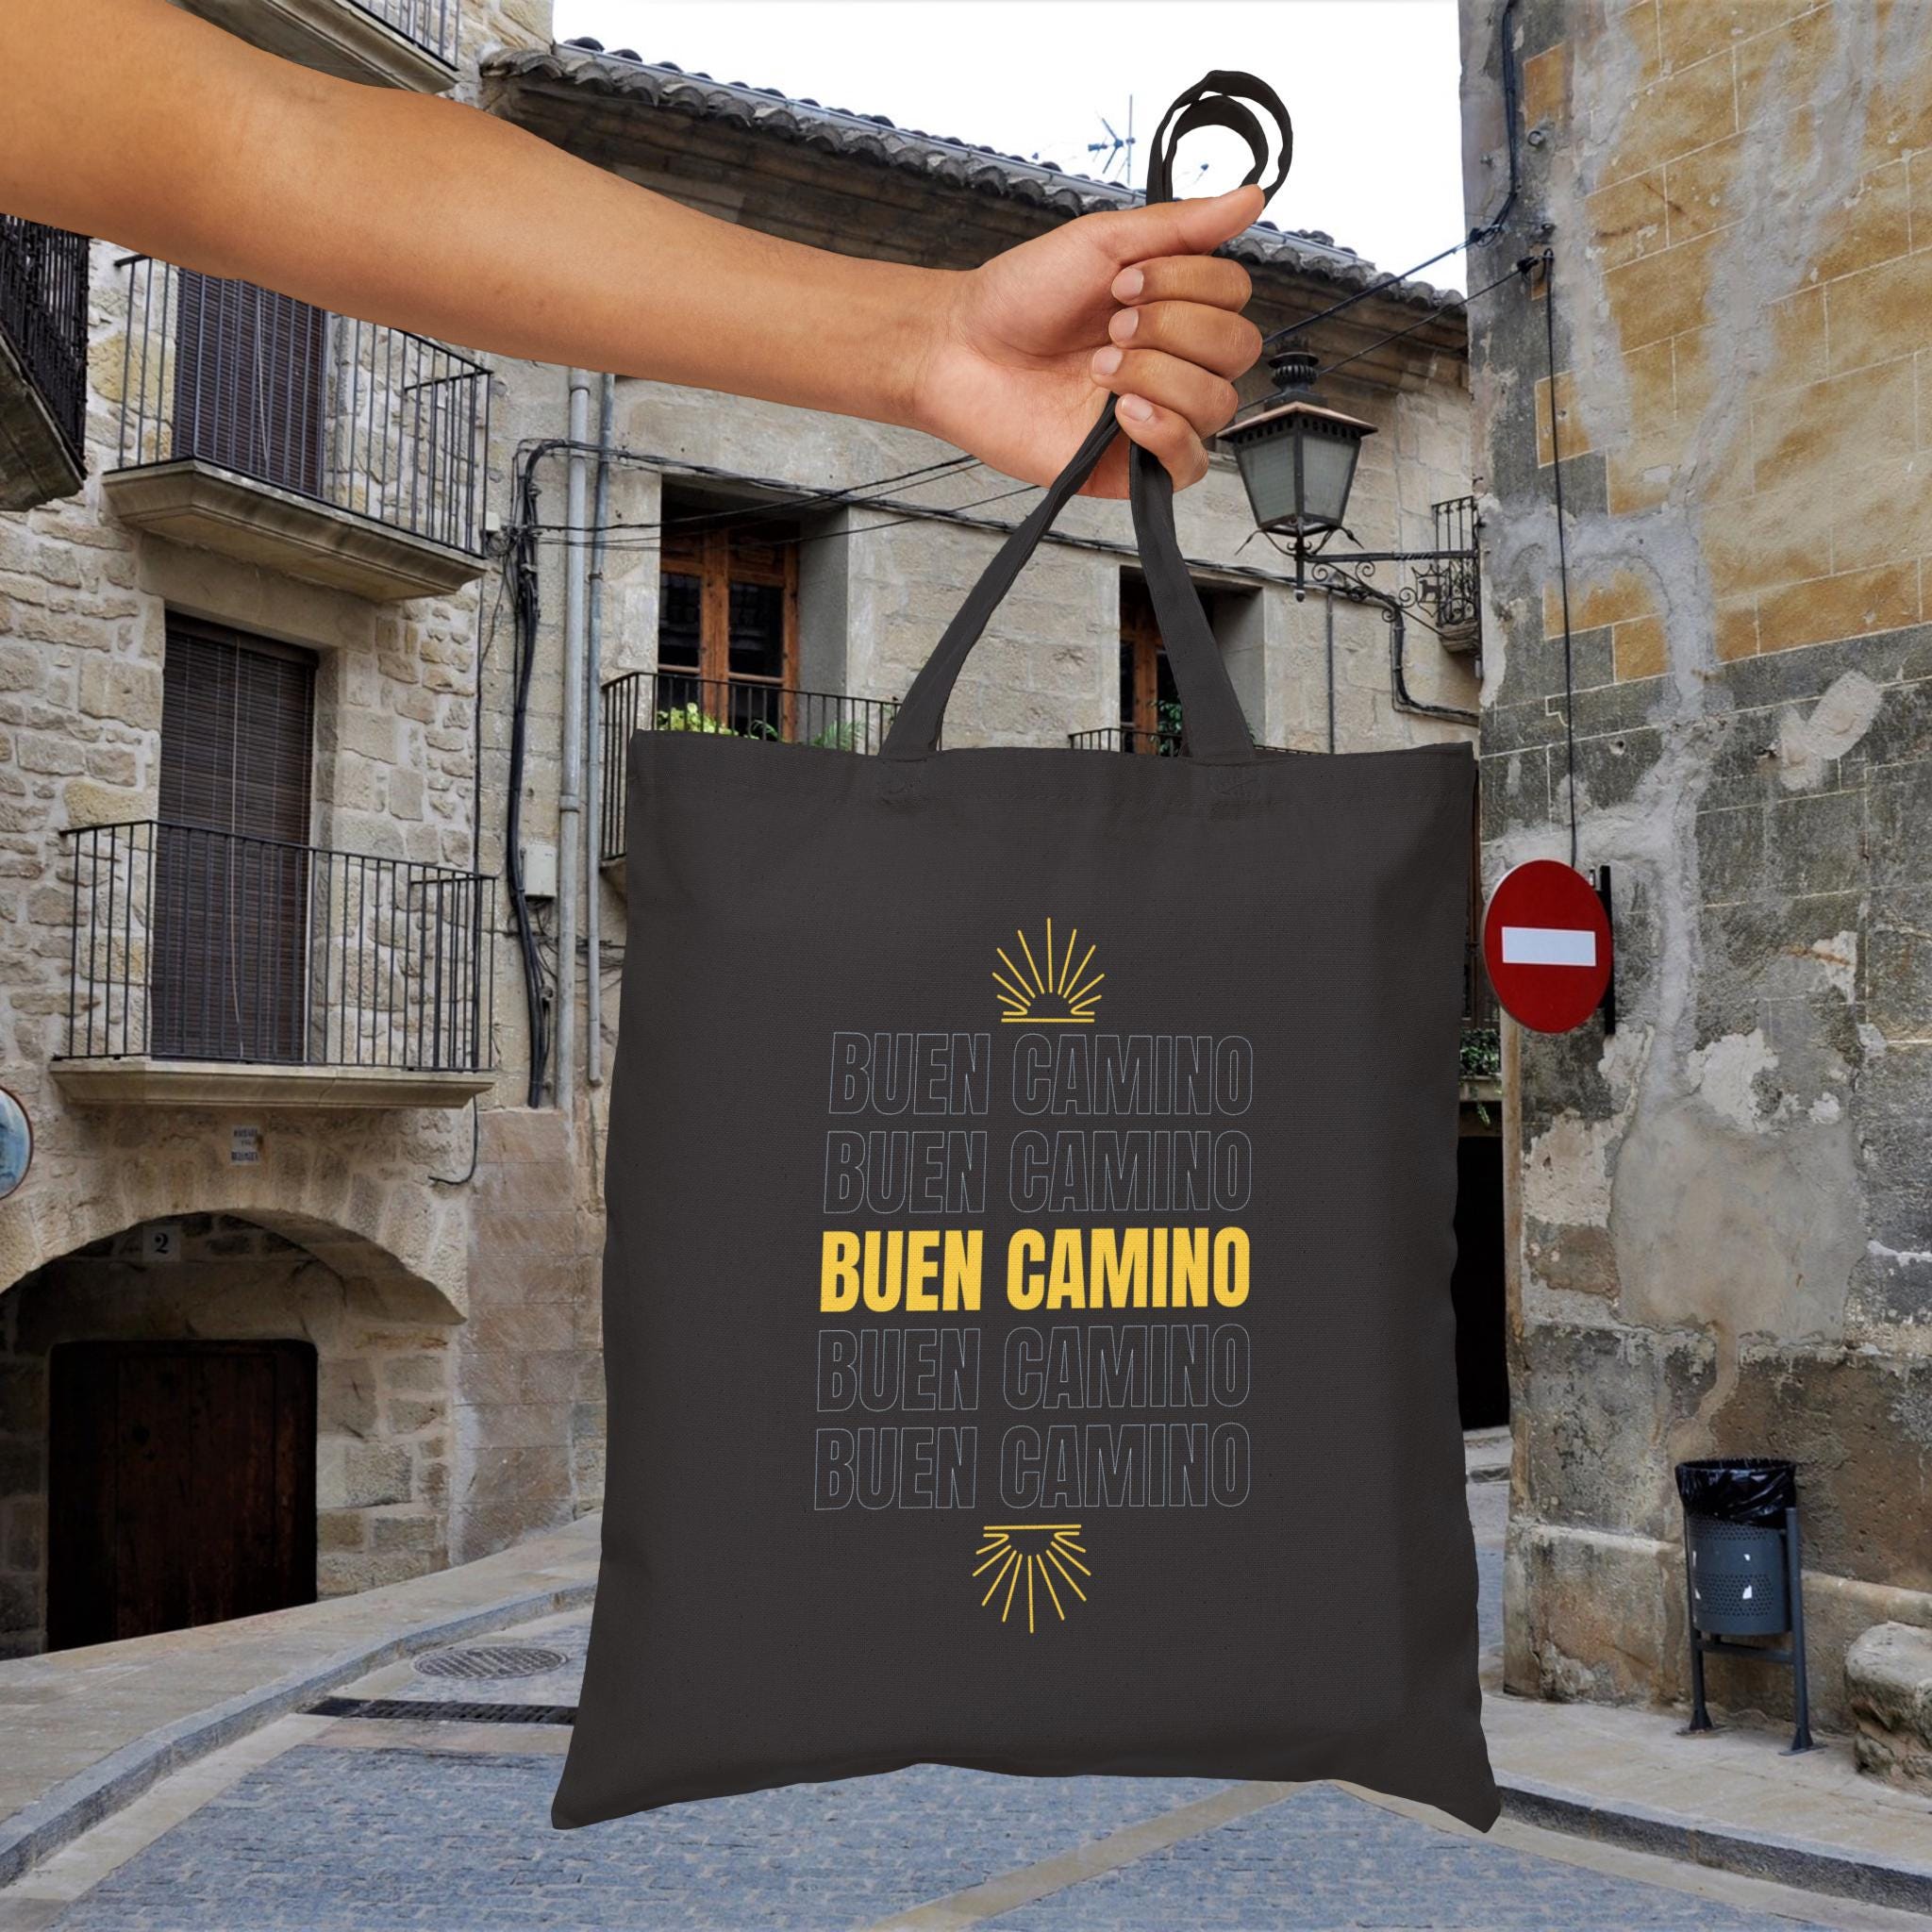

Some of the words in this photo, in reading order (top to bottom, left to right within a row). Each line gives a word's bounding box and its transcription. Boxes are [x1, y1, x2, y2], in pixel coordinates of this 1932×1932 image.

[829, 1032, 991, 1114] BUEN
[1012, 1033, 1253, 1115] CAMINO
[824, 1131, 988, 1213] BUEN
[1009, 1130, 1252, 1212] CAMINO
[155, 1232, 169, 1255] 2
[820, 1230, 983, 1312] BUEN
[1007, 1226, 1250, 1310] CAMINO
[817, 1328, 980, 1411] BUEN
[1004, 1324, 1250, 1410] CAMINO
[815, 1426, 977, 1509] BUEN
[1000, 1423, 1250, 1508] CAMINO
